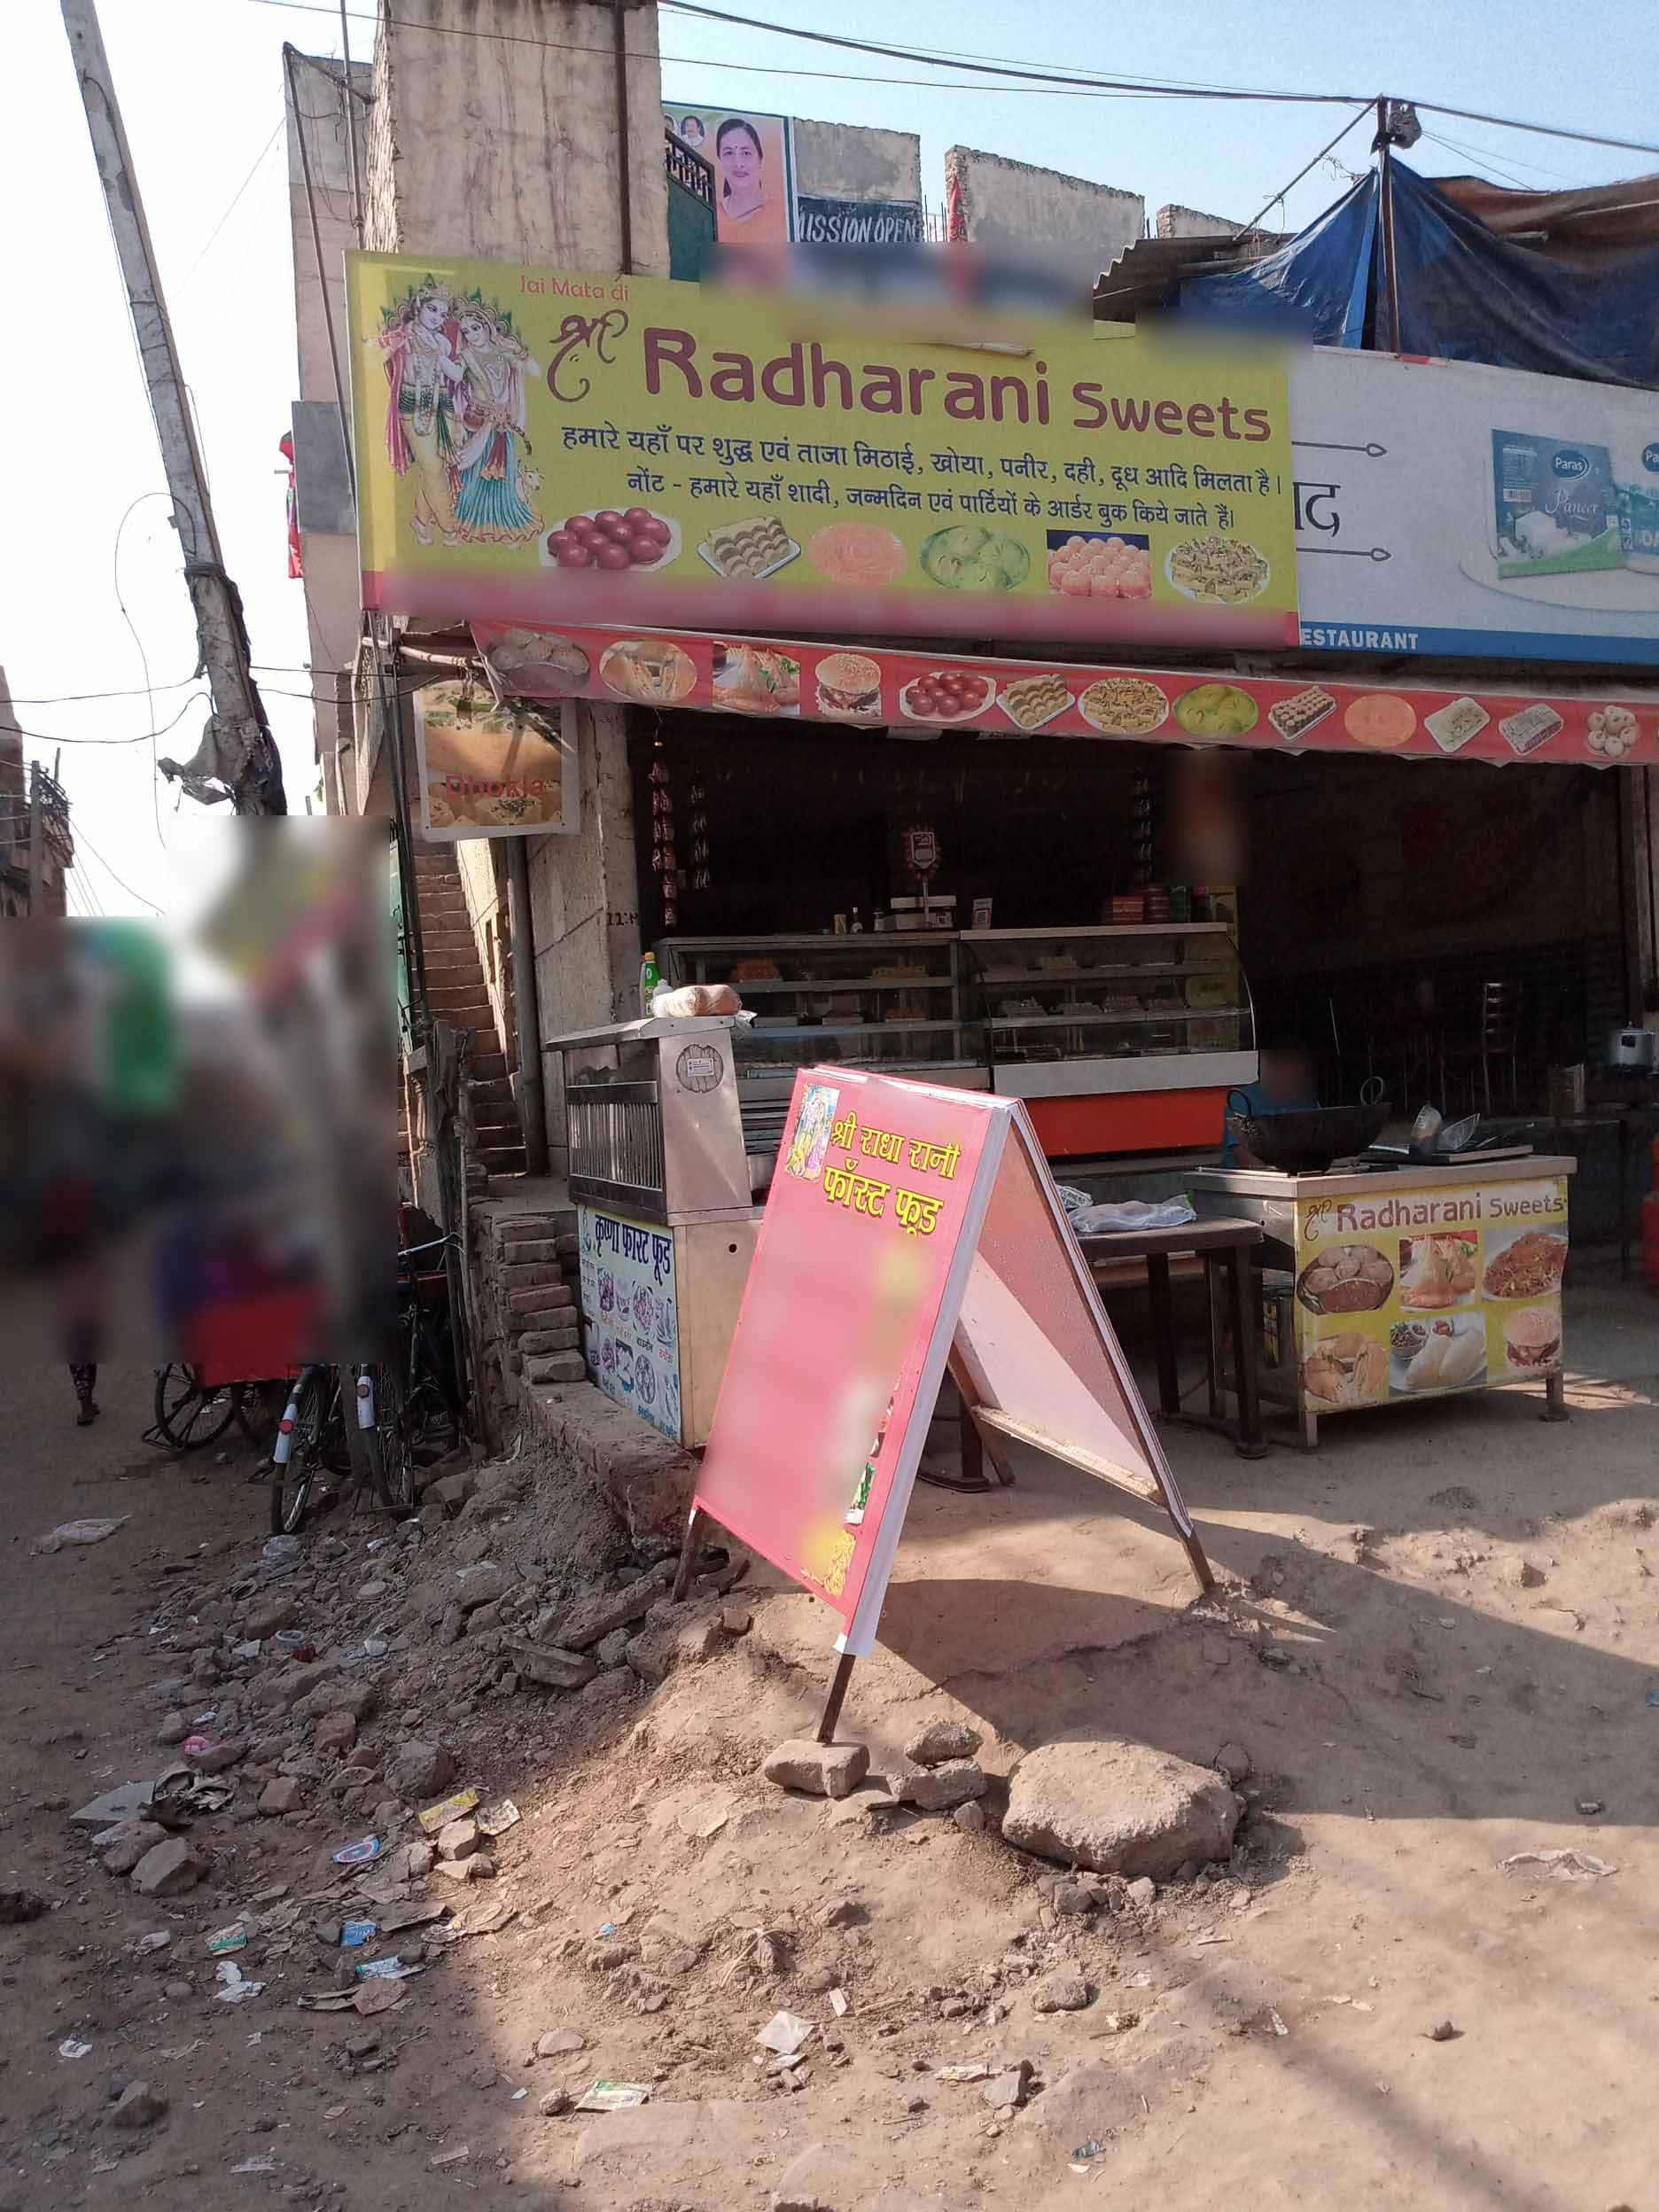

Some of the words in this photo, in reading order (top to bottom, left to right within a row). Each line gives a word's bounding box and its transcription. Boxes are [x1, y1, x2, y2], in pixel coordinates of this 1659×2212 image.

[519, 275, 546, 294] Jai
[551, 276, 605, 300] Mata
[611, 284, 628, 302] di
[643, 326, 1051, 425] Radharani
[1072, 381, 1272, 441] Sweets
[561, 419, 620, 450] हमारे
[626, 424, 673, 456] यहाँ
[675, 433, 705, 456] पर
[713, 437, 754, 467] शुद्ध
[759, 435, 791, 463] एवं
[797, 442, 848, 466] ताजा
[1110, 465, 1140, 493] दूध
[1145, 462, 1188, 489] आदि
[1193, 463, 1253, 494] मिलता
[1554, 456, 1585, 471] Paras
[689, 471, 740, 499] हमारे
[744, 472, 784, 503] यहाँ
[845, 482, 923, 510] जन्मदिन
[927, 488, 954, 513] एवं
[1023, 491, 1041, 517] के
[1047, 493, 1093, 519] आर्डर
[1097, 502, 1128, 528] बुक
[1132, 498, 1169, 525] किये
[1173, 501, 1210, 527] जाते
[1301, 627, 1419, 650] ESTAURANT
[830, 1110, 857, 1150] श्री
[859, 1125, 906, 1164] राधा
[1336, 1192, 1482, 1233] Radharani
[1489, 1196, 1565, 1219] Sweets
[651, 1233, 672, 1287] फूड
